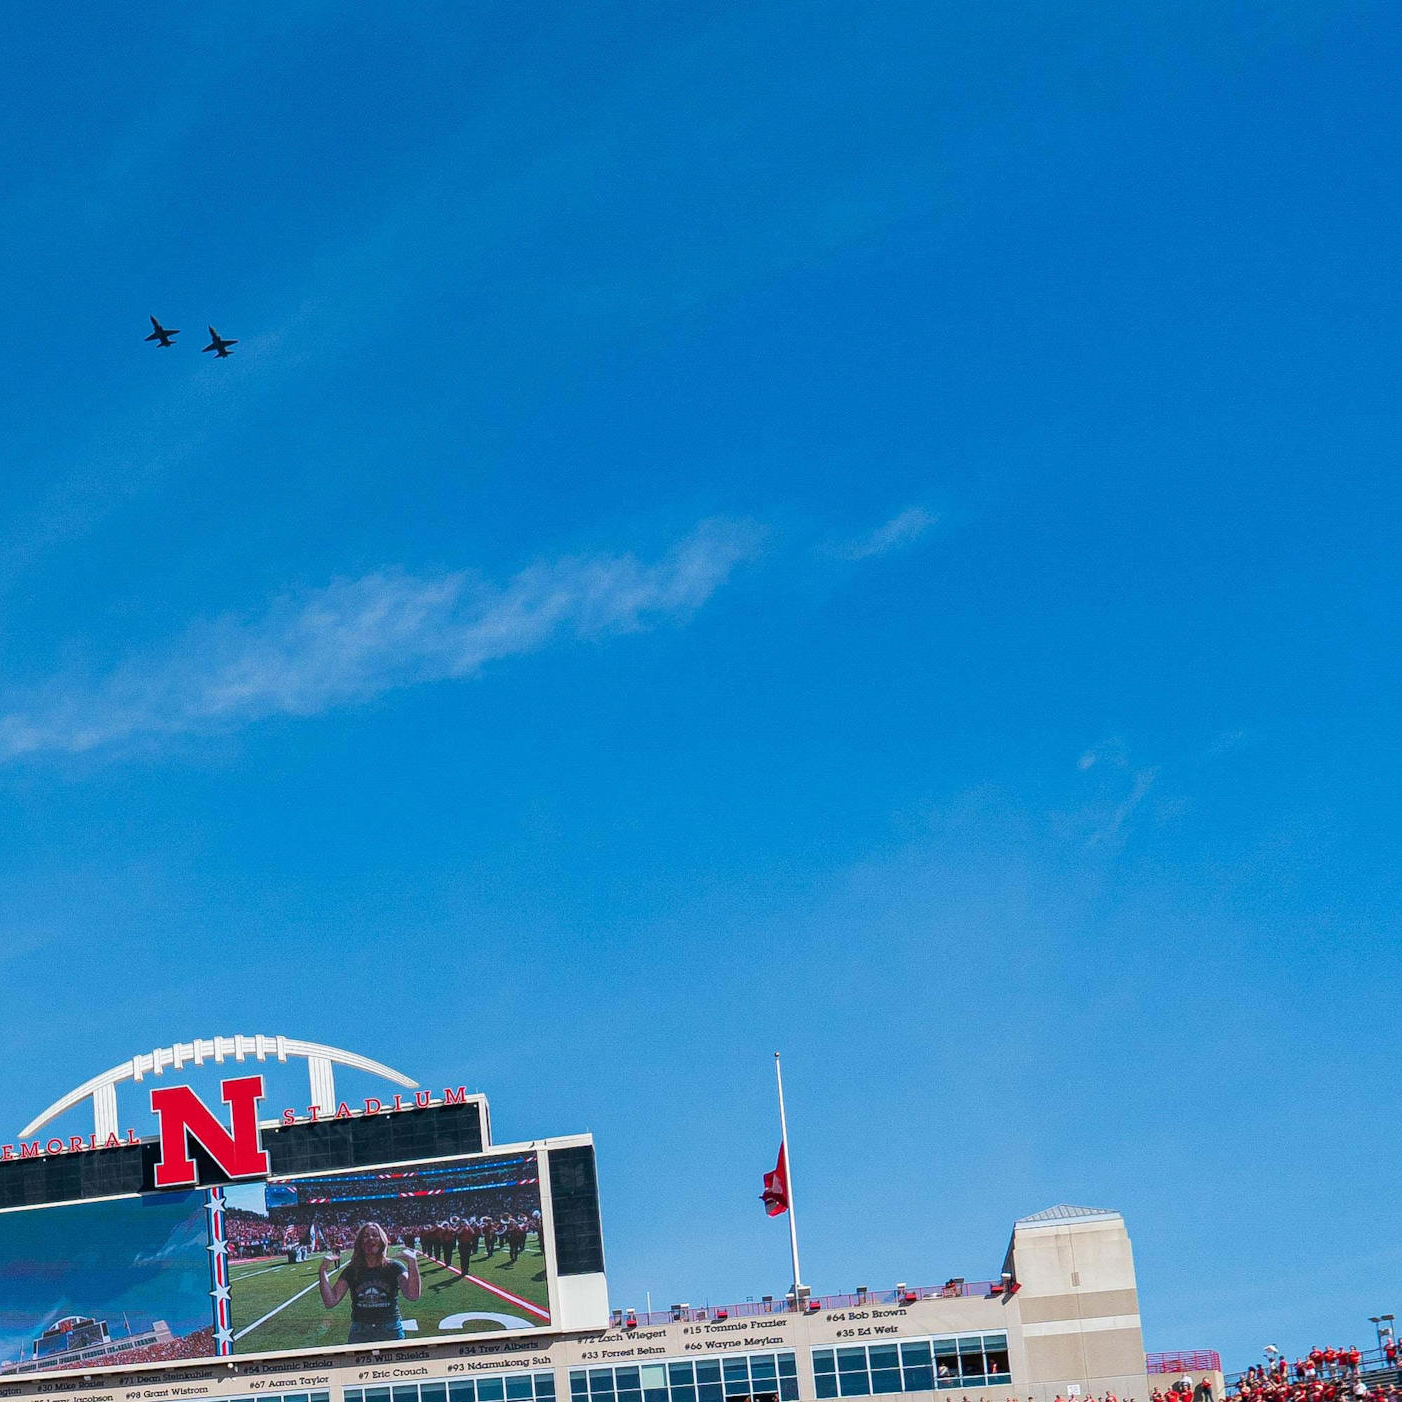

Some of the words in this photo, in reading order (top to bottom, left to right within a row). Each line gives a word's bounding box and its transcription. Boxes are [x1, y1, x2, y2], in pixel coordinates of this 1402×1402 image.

[282, 1086, 468, 1125] STADIUM
[150, 1074, 270, 1188] N
[826, 1313, 845, 1322] #64
[848, 1311, 869, 1320] Bob
[872, 1308, 907, 1318] Brown
[683, 1326, 702, 1335] #15
[704, 1322, 747, 1333] Tommie
[750, 1319, 787, 1329] Frazier
[836, 1329, 855, 1338] #35
[858, 1327, 871, 1336] Ed
[874, 1325, 899, 1334] Weir
[598, 1332, 623, 1343] Zach
[627, 1329, 667, 1340] Wiegert
[458, 1345, 477, 1355] #34
[479, 1343, 500, 1353] Trev
[503, 1341, 539, 1351] Alberts
[684, 1341, 702, 1351] #66
[705, 1338, 742, 1350] Wayne
[744, 1336, 784, 1347] Meylan
[355, 1354, 372, 1364] #75
[374, 1352, 393, 1363] Will
[395, 1350, 430, 1361] Shields
[581, 1351, 599, 1360] #33
[602, 1348, 634, 1358] Forrest
[637, 1345, 666, 1355] Behm
[262, 1362, 301, 1372] Dominic
[303, 1359, 333, 1370] Raiola
[447, 1363, 465, 1373] #93
[468, 1358, 530, 1371] Ndamukong
[532, 1356, 551, 1367] Suh
[119, 1375, 135, 1385] #71
[136, 1374, 161, 1383] Dean
[162, 1370, 213, 1382] Steinkuhler
[358, 1370, 370, 1380] #7
[372, 1368, 390, 1379] Eric
[393, 1366, 429, 1377] Crouch
[37, 1383, 53, 1392] #30
[55, 1382, 76, 1391] Mike
[249, 1379, 266, 1389] #67
[268, 1378, 297, 1388] Aaron
[299, 1375, 329, 1386] Taylor
[126, 1391, 142, 1400] #98
[143, 1388, 169, 1398] Grant
[171, 1385, 208, 1396] Wistrom
